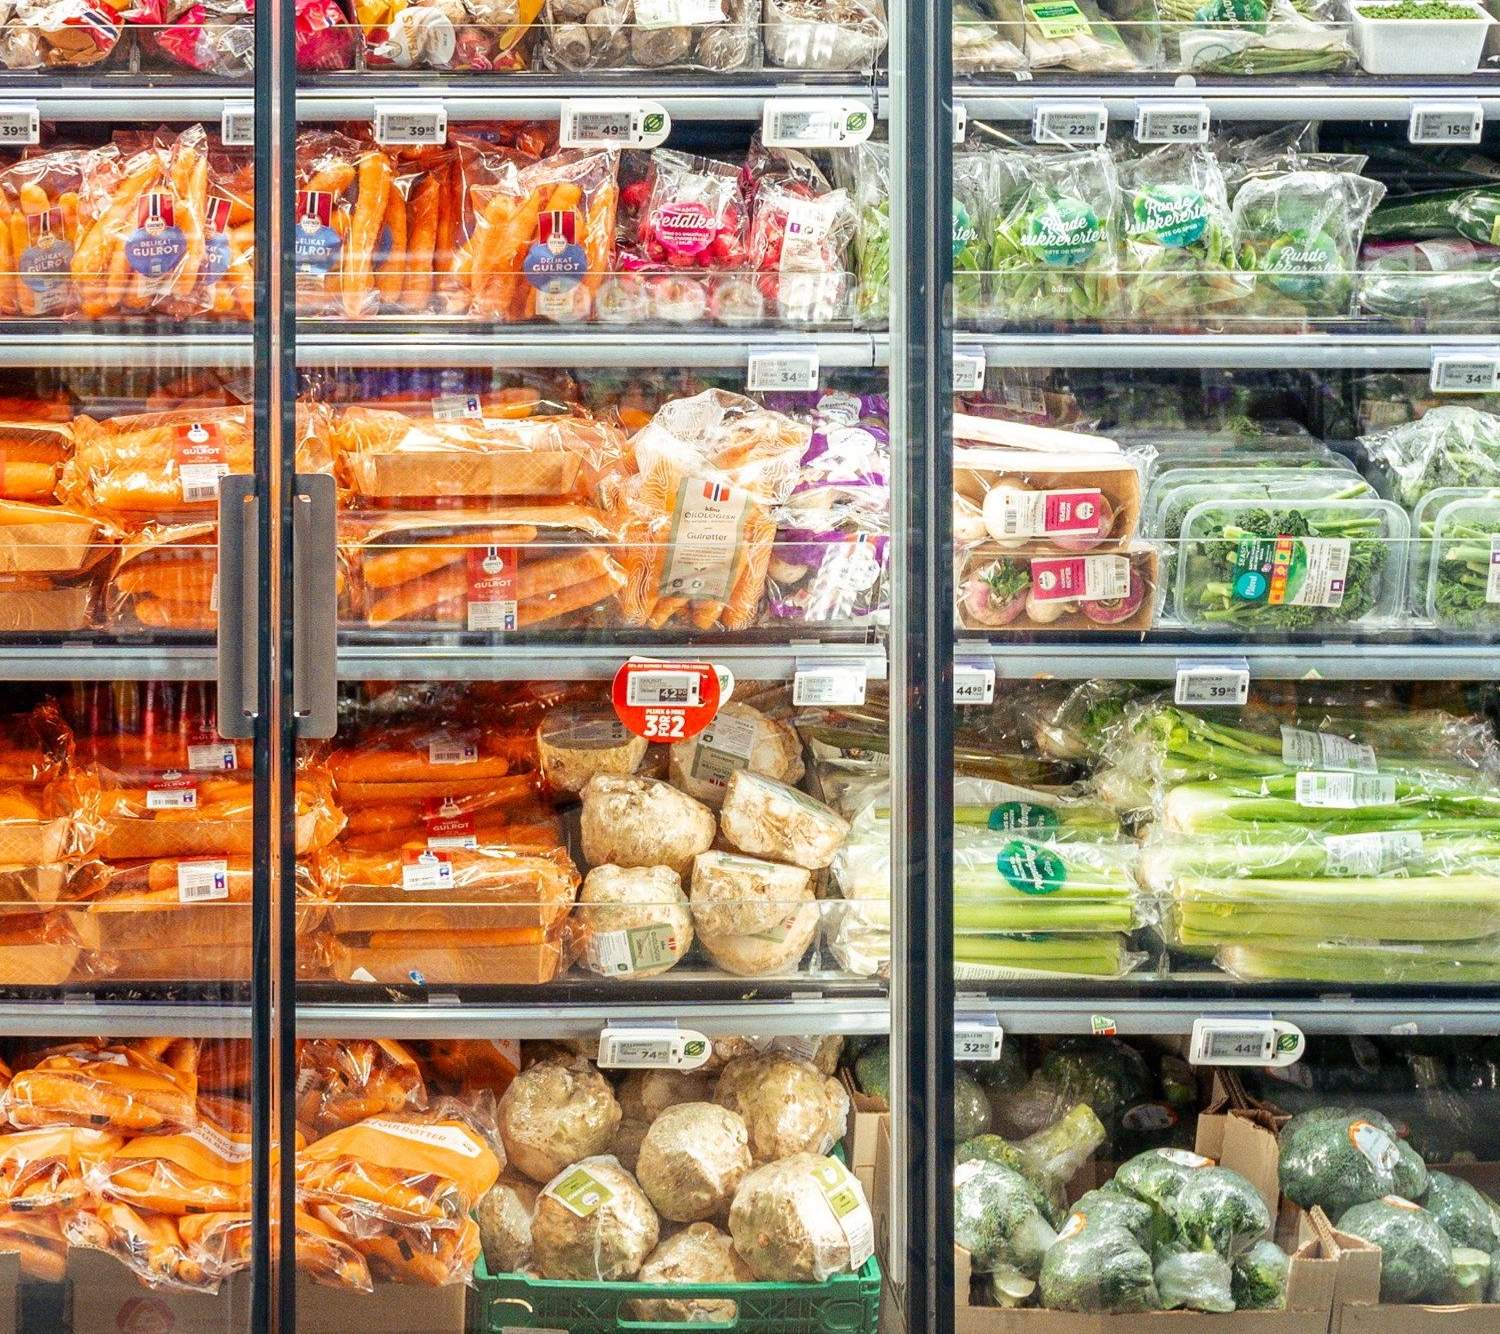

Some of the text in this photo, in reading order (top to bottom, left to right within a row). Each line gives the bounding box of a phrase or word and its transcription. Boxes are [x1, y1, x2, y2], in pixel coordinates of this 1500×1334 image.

[1144, 195, 1193, 217] Runde
[648, 210, 725, 231] Reddiker
[1041, 216, 1088, 234] Runde
[1020, 229, 1107, 248] sukkererter
[133, 245, 179, 257] GULROT
[532, 263, 580, 272] GULROT
[686, 532, 728, 542] Gulrøtter
[474, 579, 512, 589] GULROT
[643, 715, 659, 737] 3
[671, 715, 686, 737] 2
[434, 822, 470, 831] GULROT
